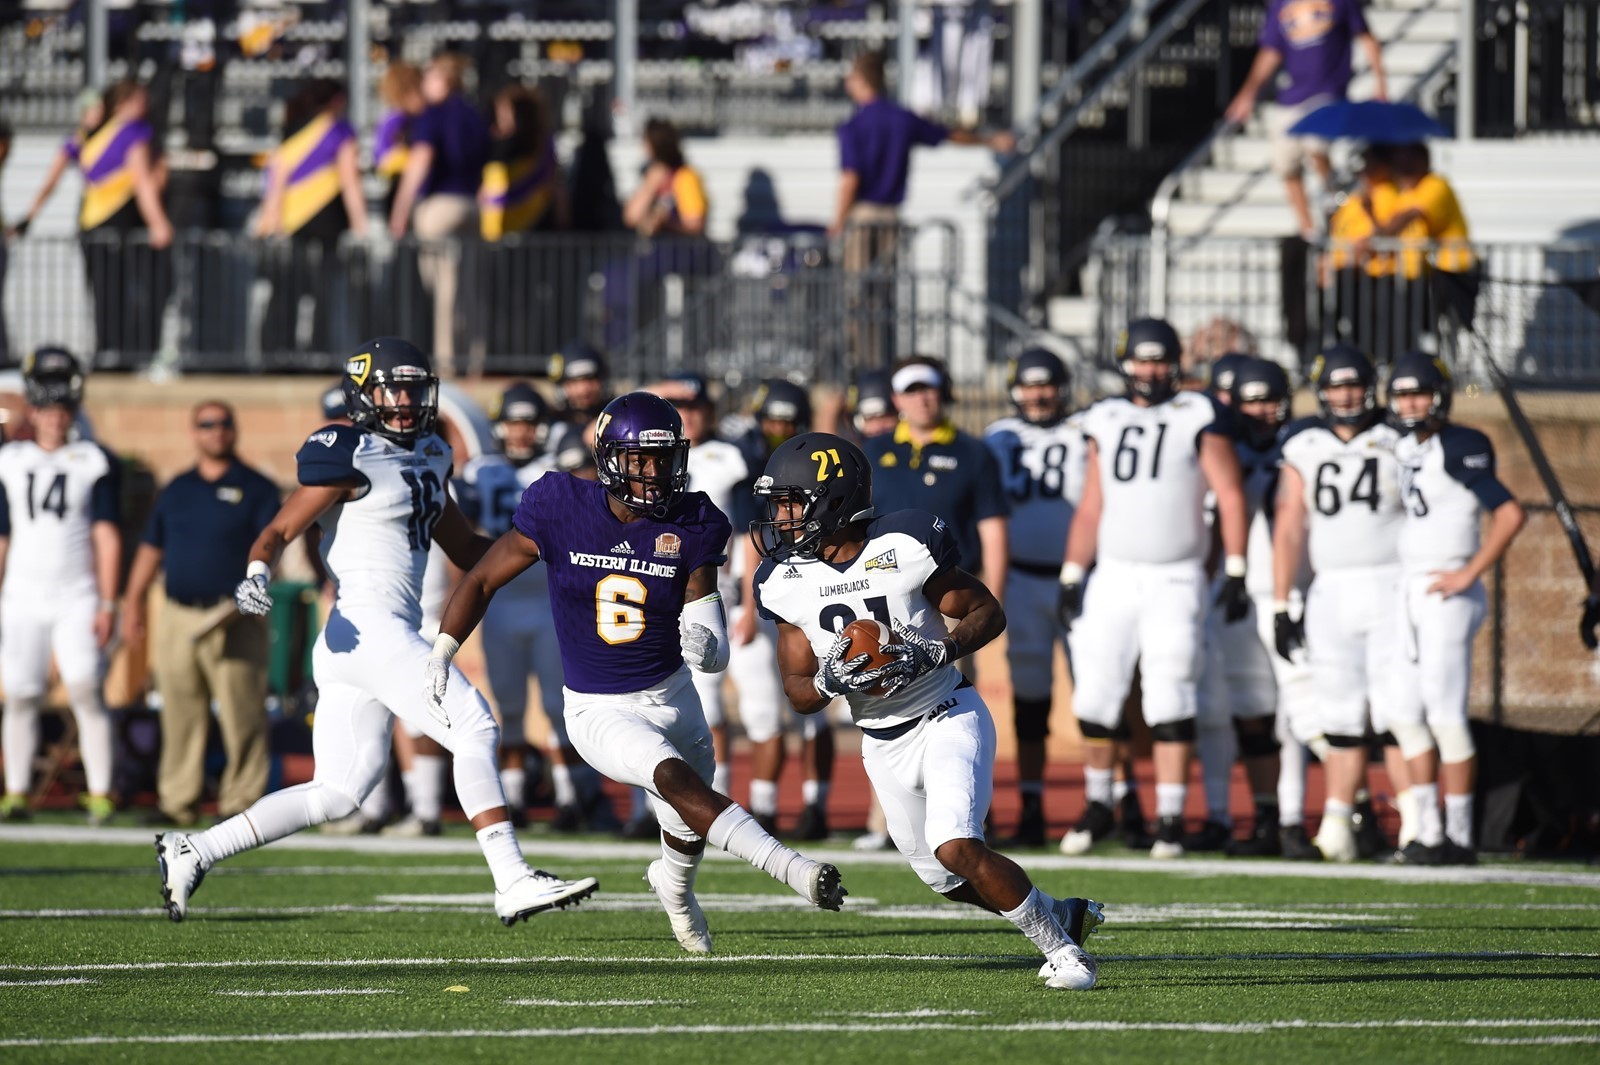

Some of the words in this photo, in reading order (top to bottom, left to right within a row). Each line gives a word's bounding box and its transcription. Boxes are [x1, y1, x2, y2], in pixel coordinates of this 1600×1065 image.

[811, 448, 843, 482] 21
[1010, 443, 1067, 502] 58
[1113, 423, 1167, 481] 61
[28, 472, 69, 519] 14
[400, 469, 441, 552] 16
[1315, 457, 1380, 517] 64
[569, 551, 627, 571] WESTERN
[629, 559, 677, 578] ILLINOIS
[610, 547, 635, 555] adidas
[595, 573, 648, 645] 6
[819, 578, 870, 597] LUMBERJACKS
[927, 697, 959, 721] NAU
